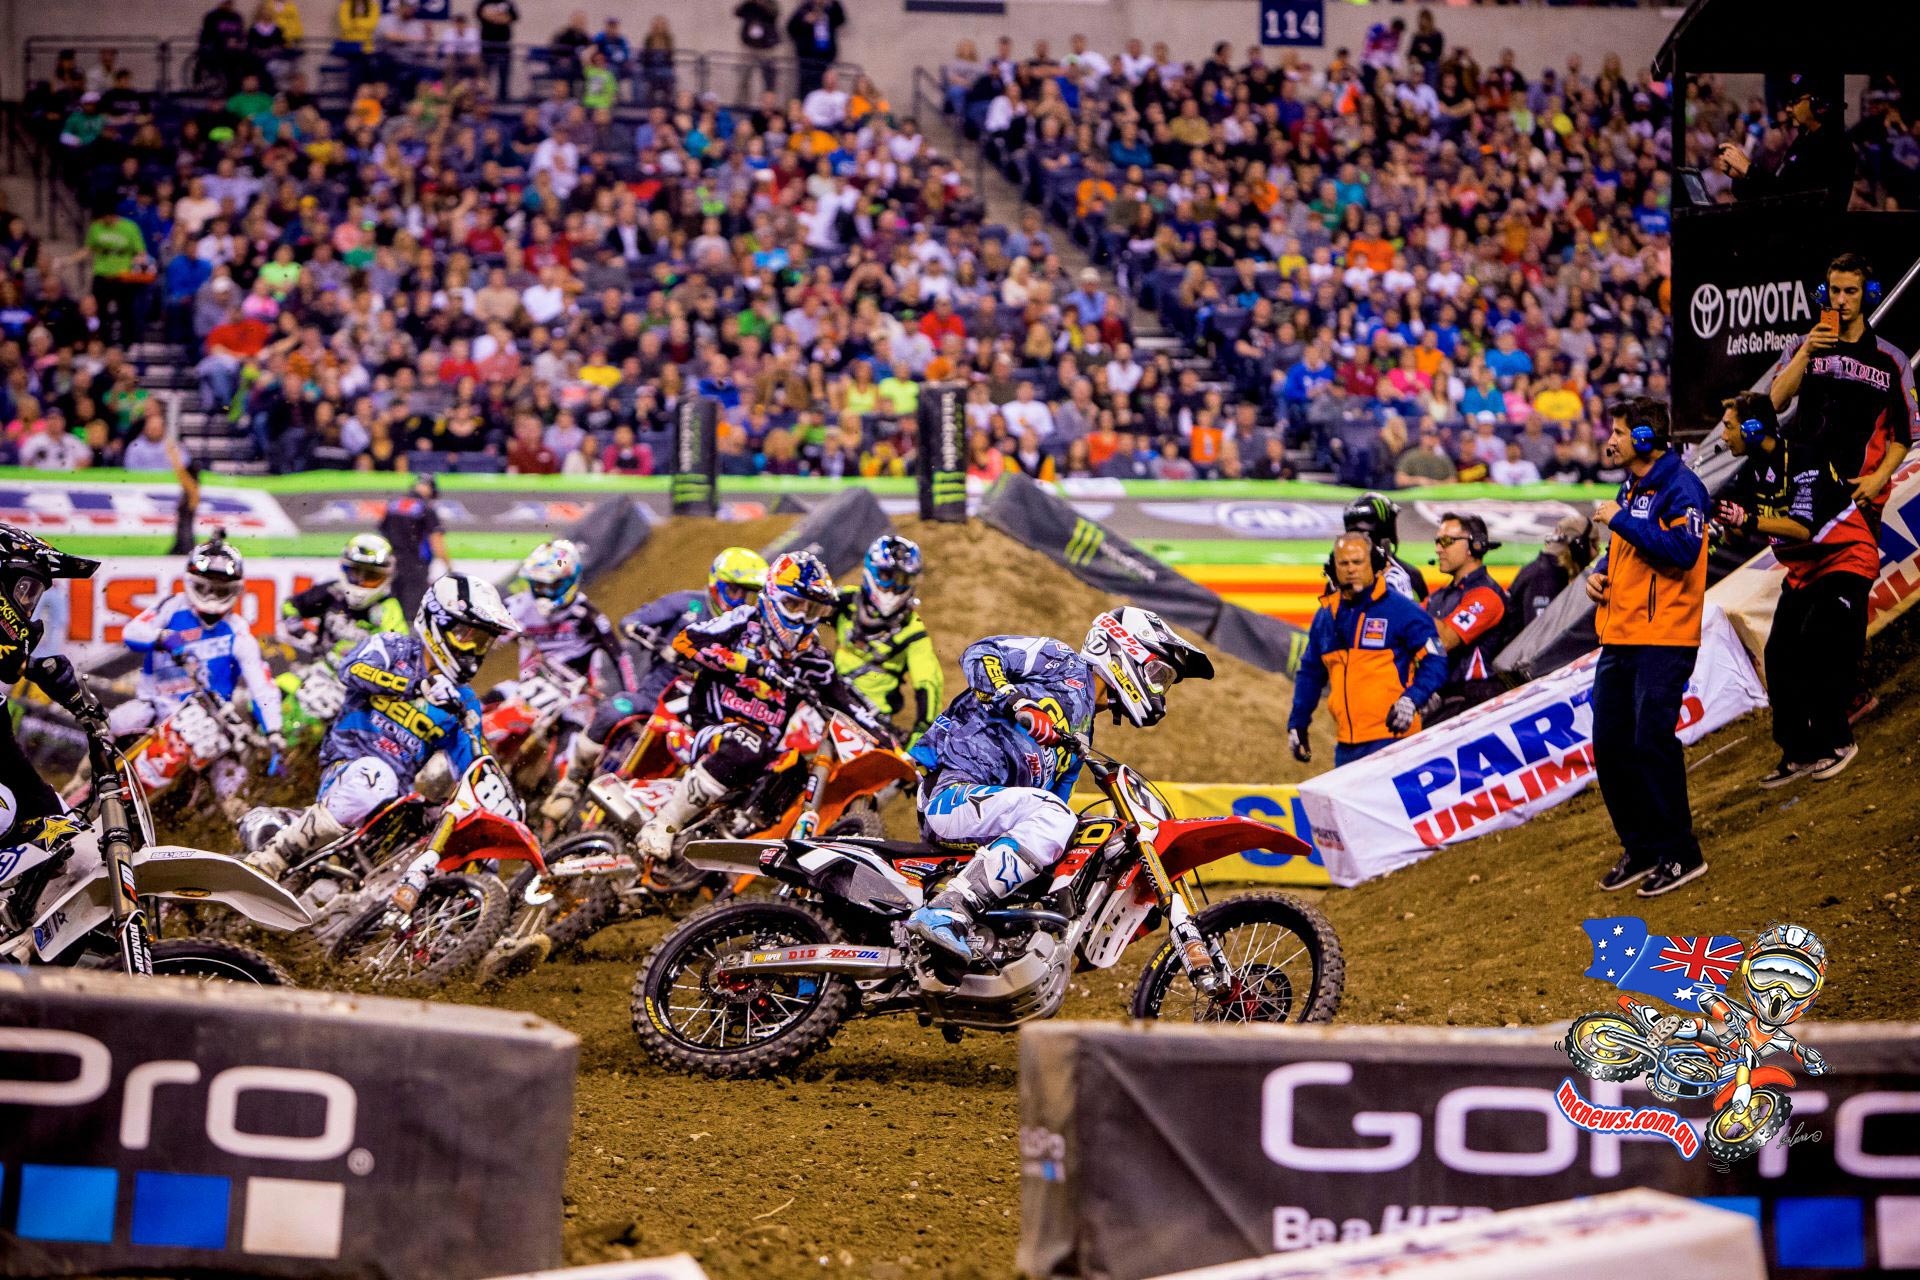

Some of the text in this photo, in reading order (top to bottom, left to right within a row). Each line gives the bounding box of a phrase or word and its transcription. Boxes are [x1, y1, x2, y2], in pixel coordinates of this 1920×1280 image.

[1264, 9, 1321, 39] 114
[1726, 280, 1811, 329] TOYOTA
[1750, 332, 1763, 353] Go
[1107, 660, 1142, 703] GEICO
[129, 922, 145, 974] DUNLOP
[824, 948, 881, 960] AMSOIL
